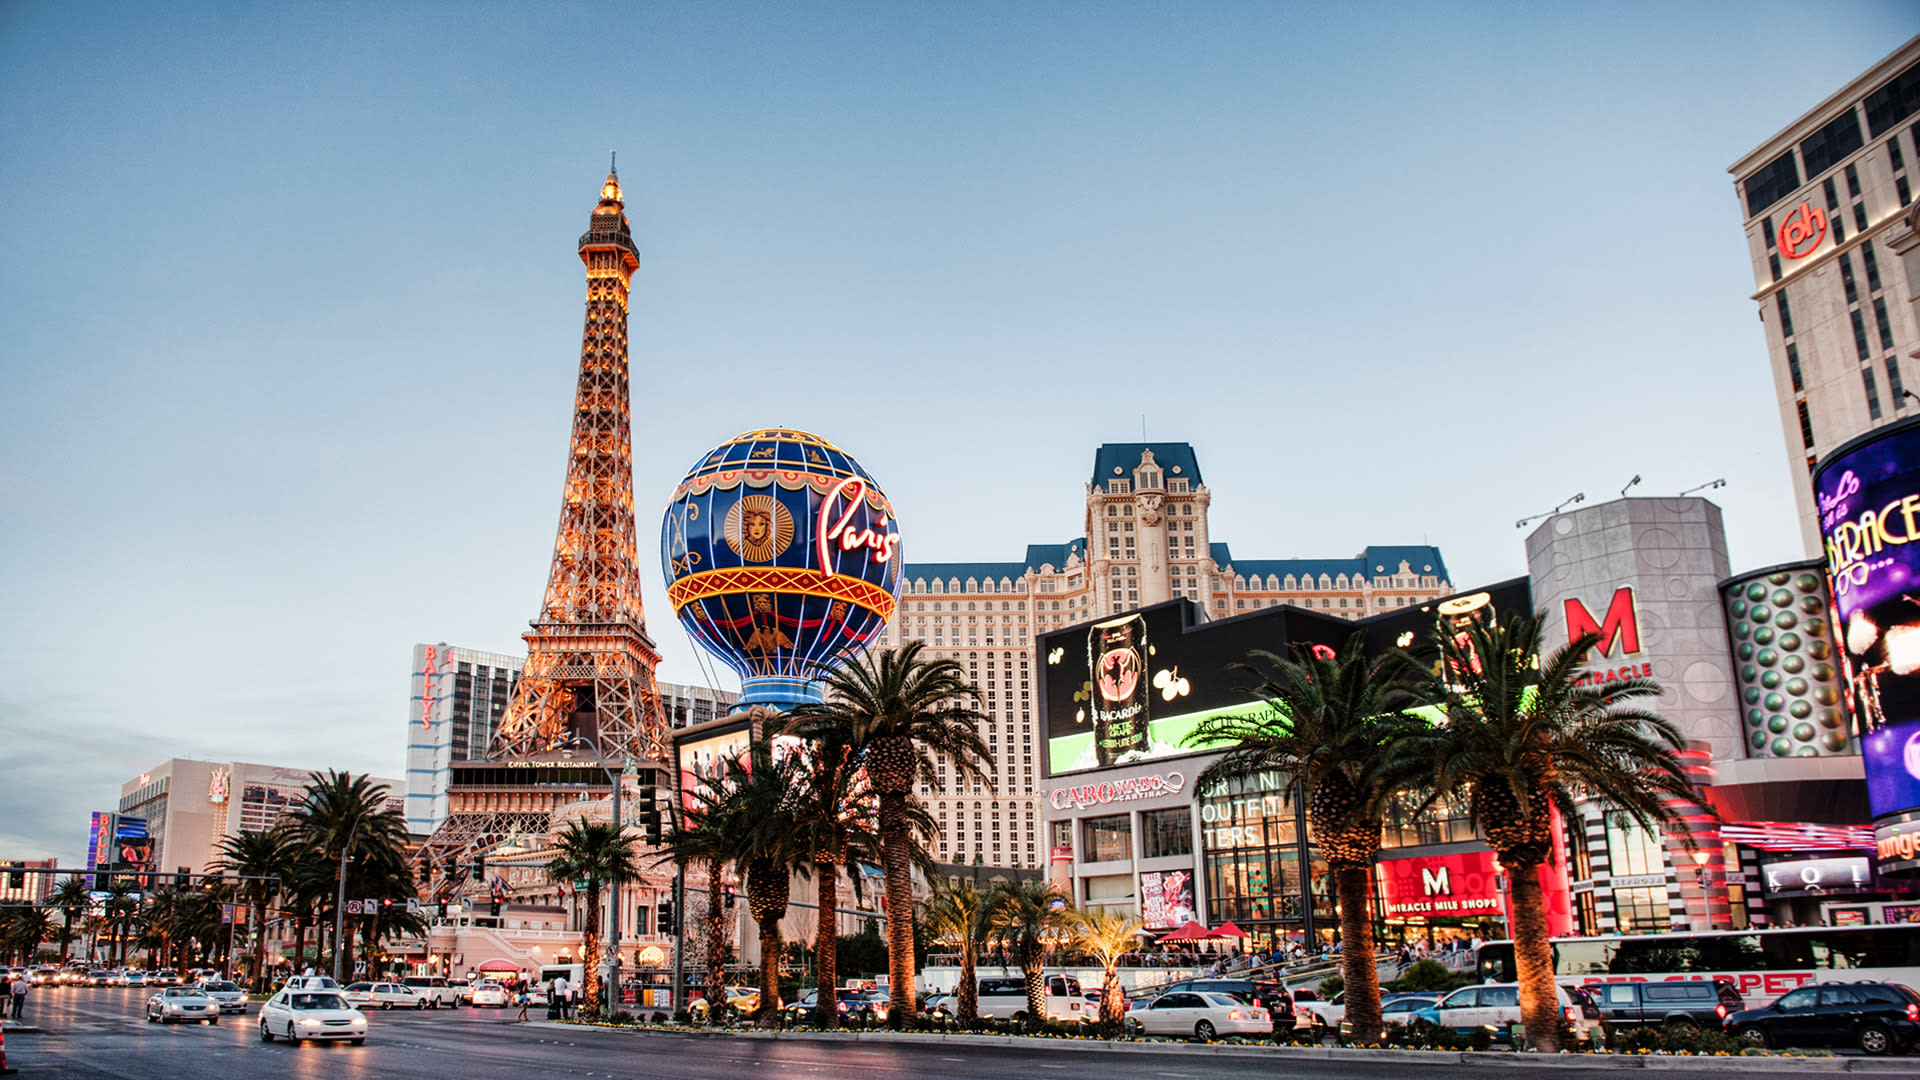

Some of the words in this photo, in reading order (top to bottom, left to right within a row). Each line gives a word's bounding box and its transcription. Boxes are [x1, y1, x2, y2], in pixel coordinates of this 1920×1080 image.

[1783, 203, 1826, 255] ph
[816, 476, 900, 577] Paris
[1564, 587, 1640, 663] M
[1050, 782, 1115, 810] CABO
[1114, 775, 1163, 796] WABO
[1202, 796, 1279, 822] OUTFIT
[1203, 826, 1259, 848] TERS
[1422, 867, 1453, 896] M
[1389, 902, 1432, 913] MIRACLE
[1435, 900, 1458, 910] MILE
[1461, 898, 1497, 909] SHOPS
